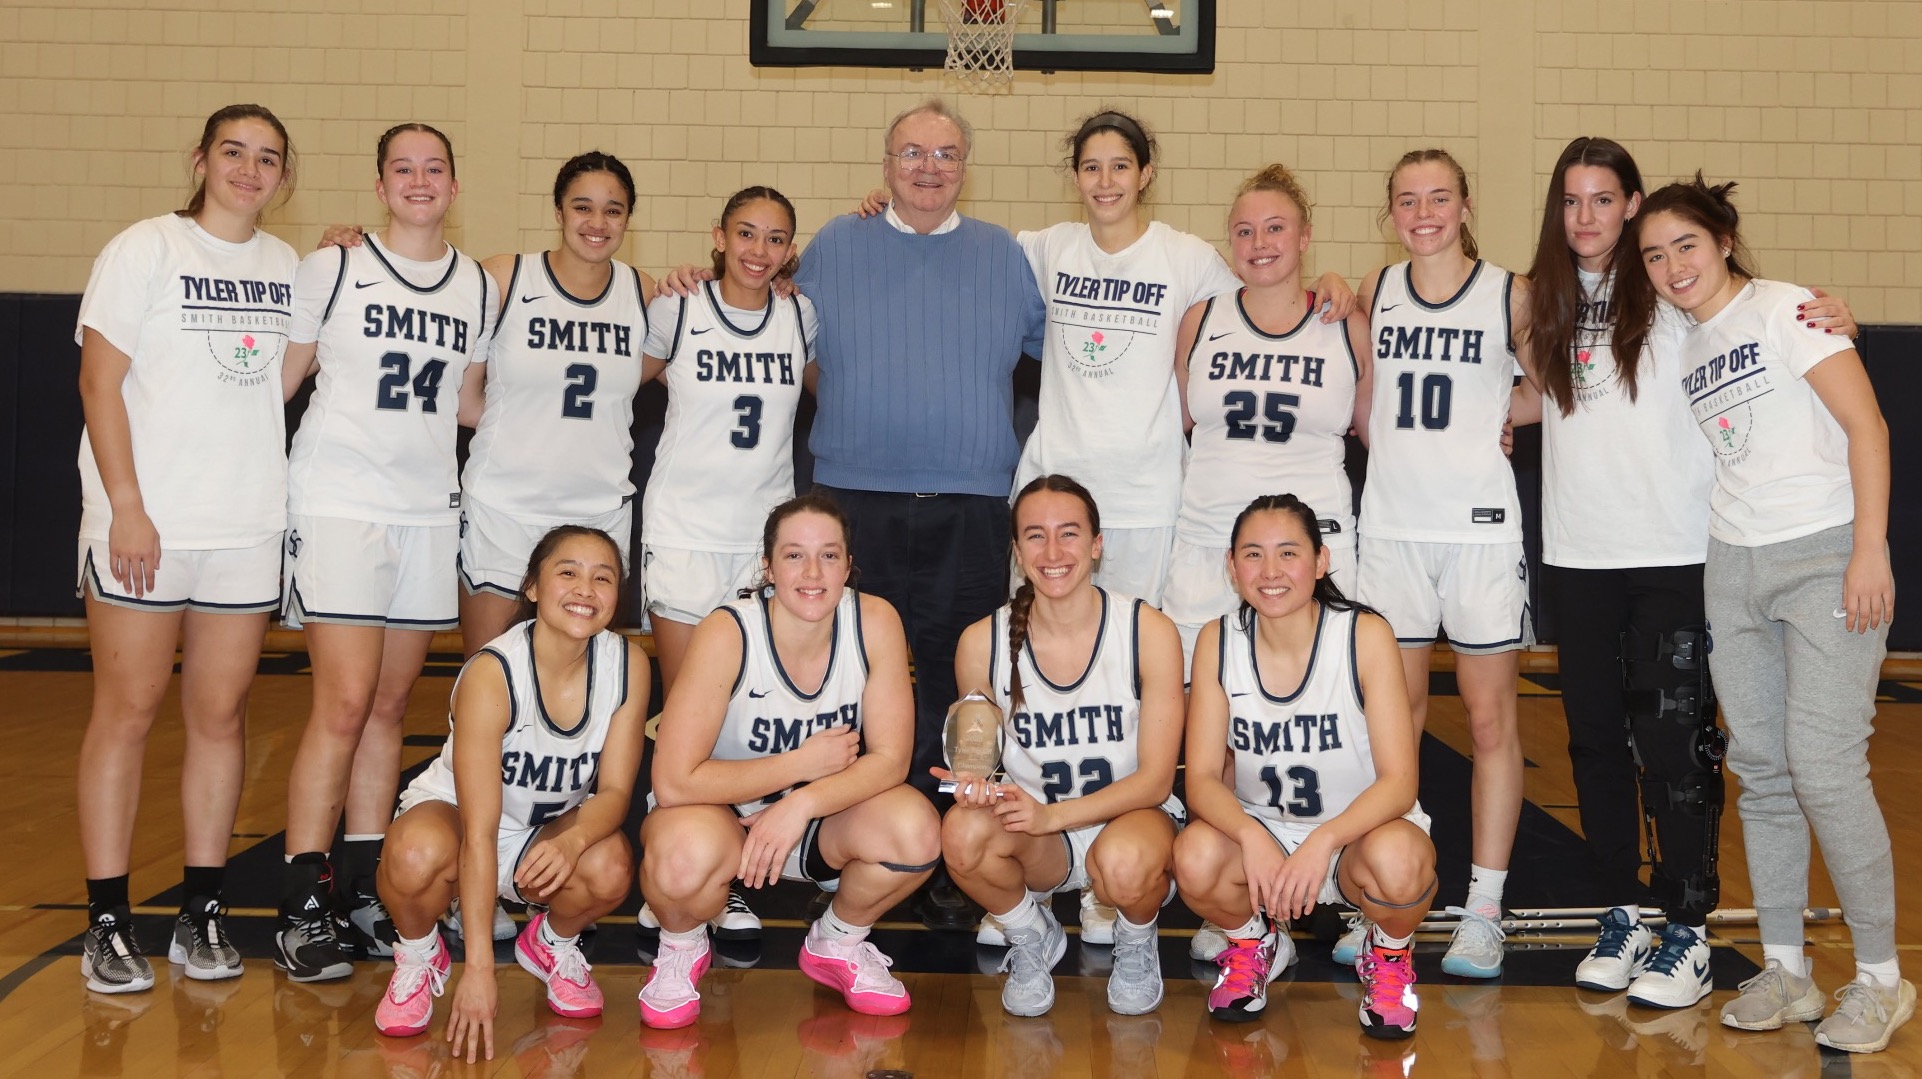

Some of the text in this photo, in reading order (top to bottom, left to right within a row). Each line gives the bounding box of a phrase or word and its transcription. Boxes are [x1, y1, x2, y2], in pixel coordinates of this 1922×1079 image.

[180, 275, 292, 307] TYLER TIP OFF
[1055, 271, 1168, 306] TYLER TIP OFF
[181, 313, 223, 324] SMITH
[363, 303, 468, 354] SMITH
[527, 317, 632, 357] SMITH
[1051, 306, 1158, 328] SMITH BASKETBALL
[234, 347, 247, 359] 23
[1082, 341, 1095, 353] 23
[1377, 326, 1484, 364] SMITH
[1708, 354, 1726, 385] TIP
[1729, 342, 1760, 373] OFF
[375, 350, 449, 415] 24
[696, 349, 795, 386] SMITH
[1082, 367, 1114, 379] ANNUAL
[1208, 351, 1325, 388] SMITH
[561, 362, 599, 420] 2
[1395, 371, 1453, 431] 10
[1702, 376, 1770, 412] BASKETBALL
[729, 394, 764, 450] 3
[1222, 389, 1301, 444] 25
[1013, 704, 1124, 749] SMITH
[1233, 713, 1342, 756] SMITH
[1040, 756, 1114, 804] 22
[1259, 765, 1324, 818] 13
